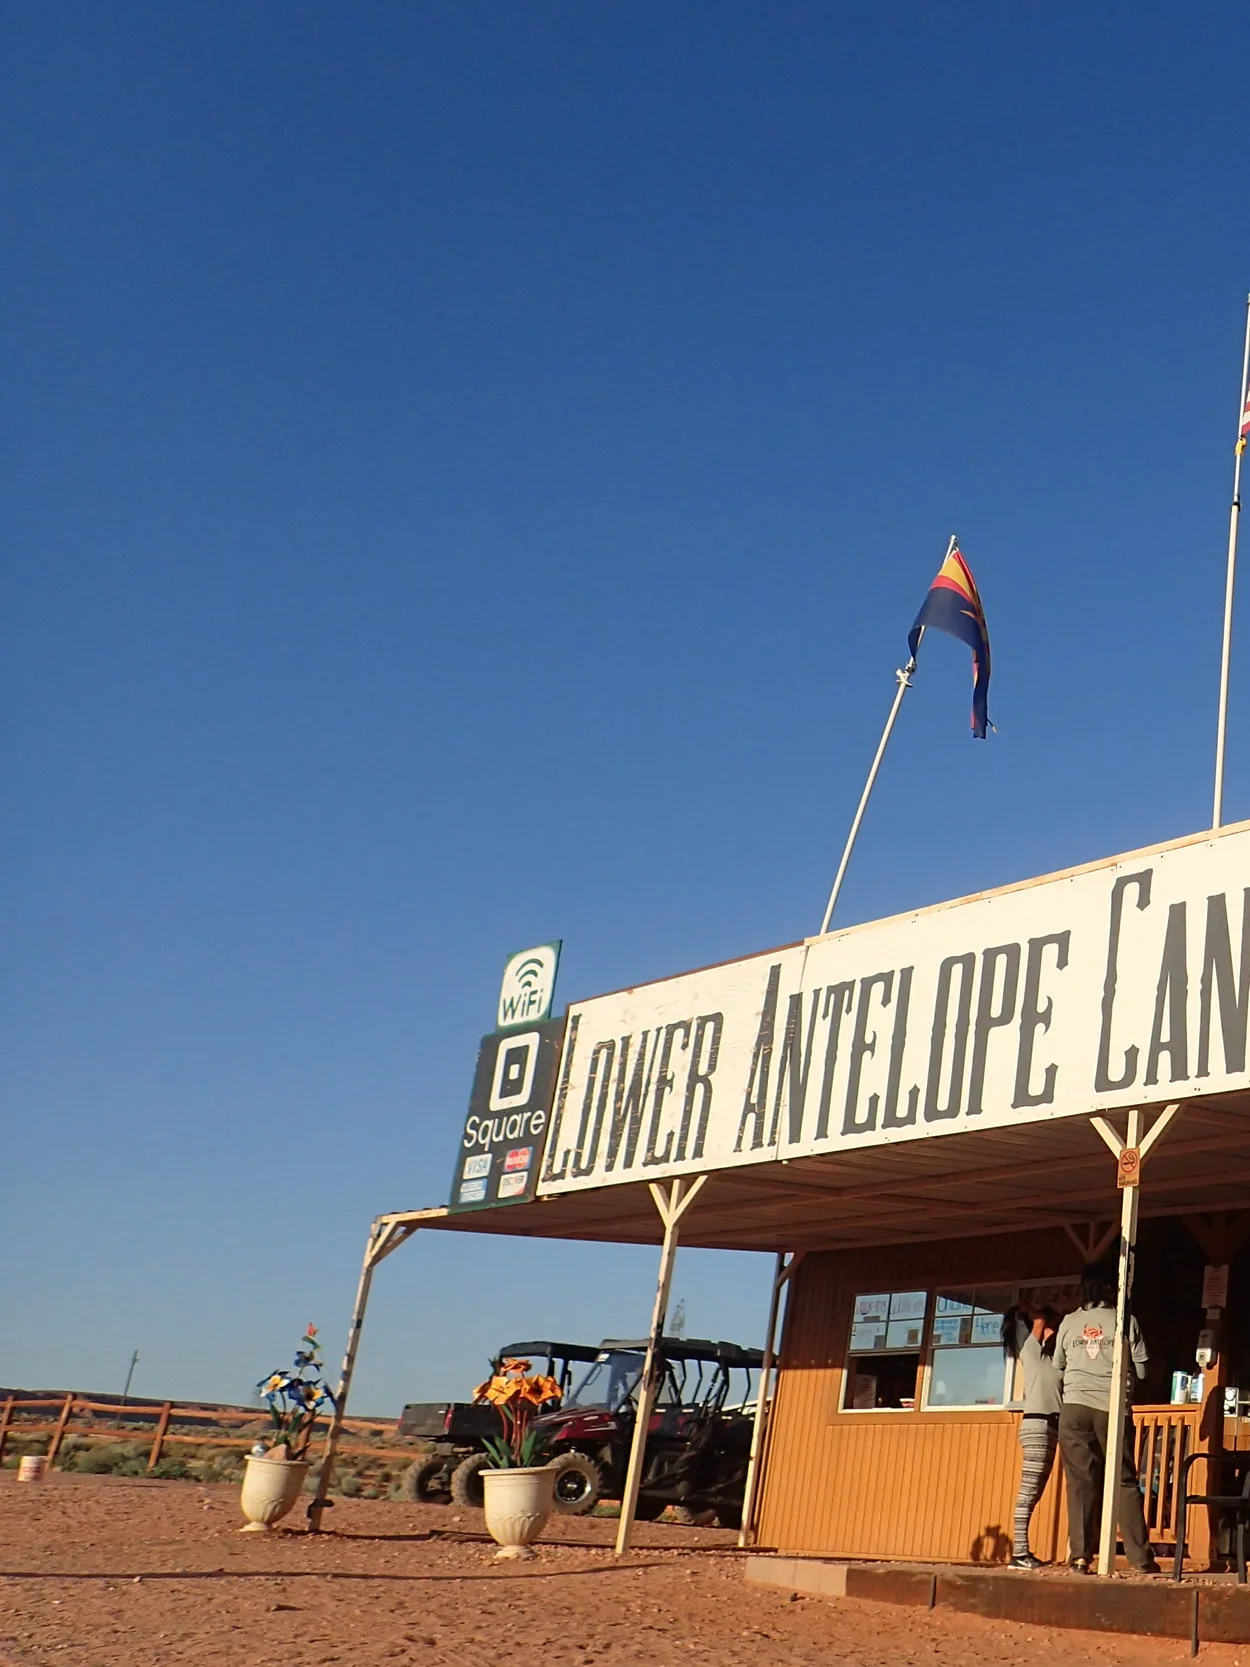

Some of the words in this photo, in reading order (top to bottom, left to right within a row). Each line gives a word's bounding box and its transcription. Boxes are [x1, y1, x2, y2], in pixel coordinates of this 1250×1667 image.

[503, 988, 544, 1021] WiFi
[542, 1011, 724, 1183] LOWER
[733, 929, 1071, 1153] ANTELOPE
[463, 1110, 546, 1151] Square
